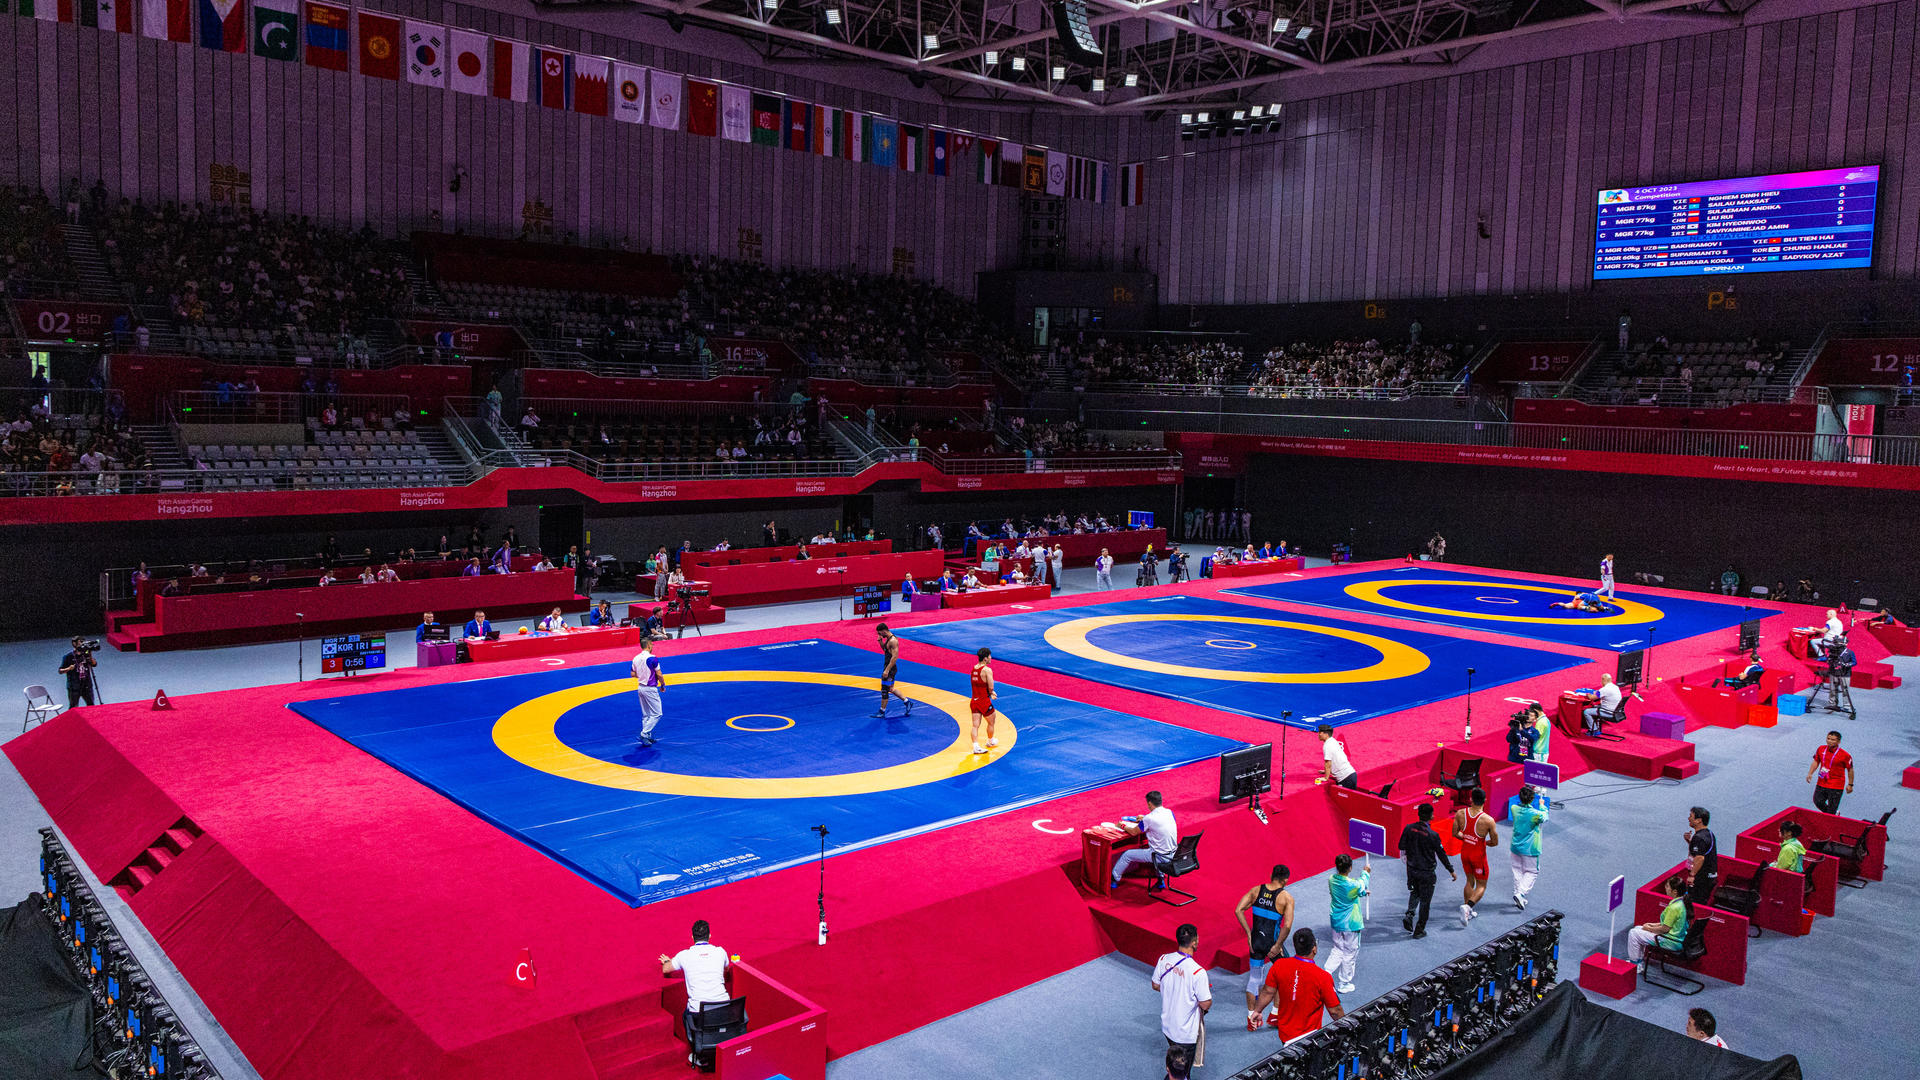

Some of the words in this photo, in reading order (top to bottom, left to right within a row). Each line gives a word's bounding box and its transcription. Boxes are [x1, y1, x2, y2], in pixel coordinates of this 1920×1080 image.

[1634, 192, 1680, 200] Competition
[1722, 219, 1767, 227] HYEONWOO
[1782, 253, 1820, 261] SADYKOV
[39, 311, 72, 333] 02
[76, 313, 101, 324] 出口
[725, 347, 742, 361] 16
[1529, 355, 1550, 371] 13
[1871, 354, 1899, 372] 12
[641, 489, 677, 498] Hangzhou
[795, 484, 826, 493] Hangzhou
[400, 497, 445, 506] Hangzhou
[158, 504, 213, 515] Hangzhou
[338, 643, 353, 652] KOR
[356, 641, 369, 650] IRI
[329, 659, 336, 668] 3
[345, 657, 364, 667] 0:56
[372, 656, 379, 664] 9
[157, 696, 166, 707] C
[1032, 819, 1075, 834] C
[1258, 897, 1273, 907] CHN
[516, 962, 528, 981] C
